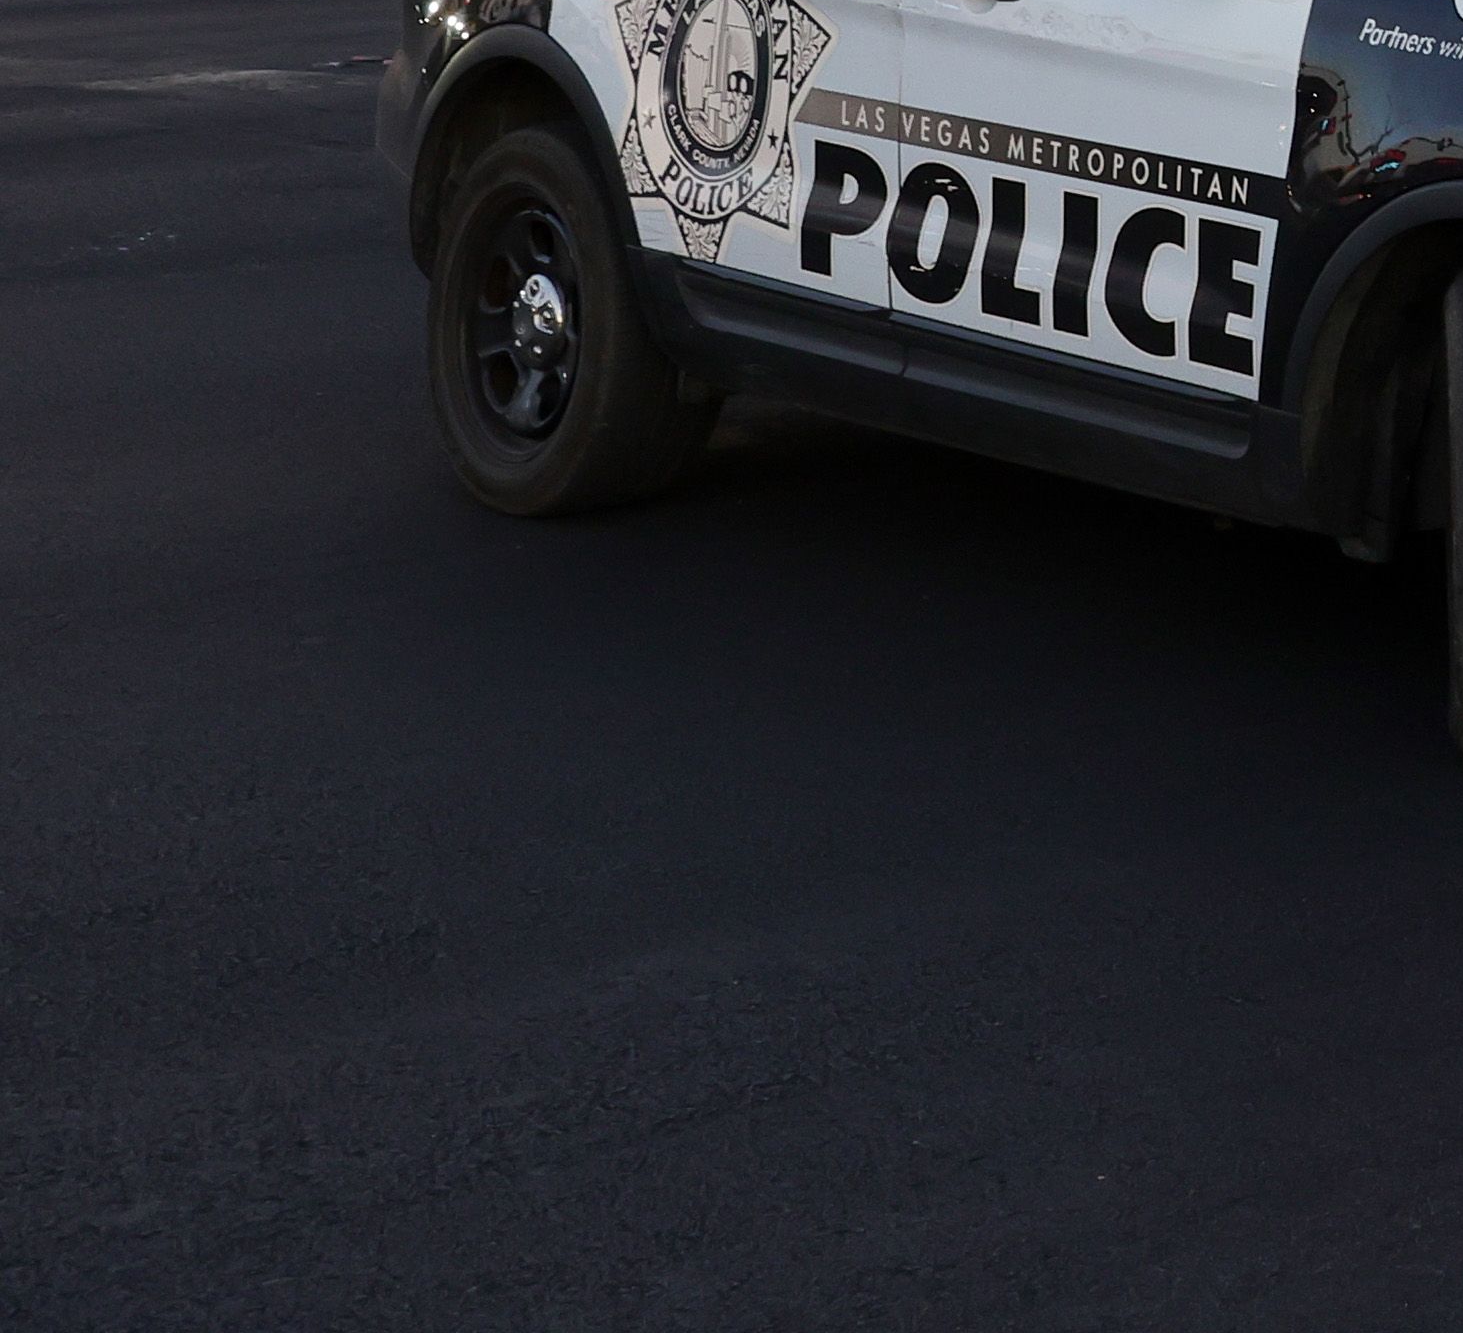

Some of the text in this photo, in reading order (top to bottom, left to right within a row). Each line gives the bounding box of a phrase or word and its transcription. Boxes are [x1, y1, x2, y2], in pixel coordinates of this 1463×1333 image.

[1359, 17, 1436, 55] Partners
[659, 154, 753, 215] POLICE
[841, 100, 1250, 206] LAS VEGAS METROPOLITAN
[799, 138, 1264, 378] POLICE
